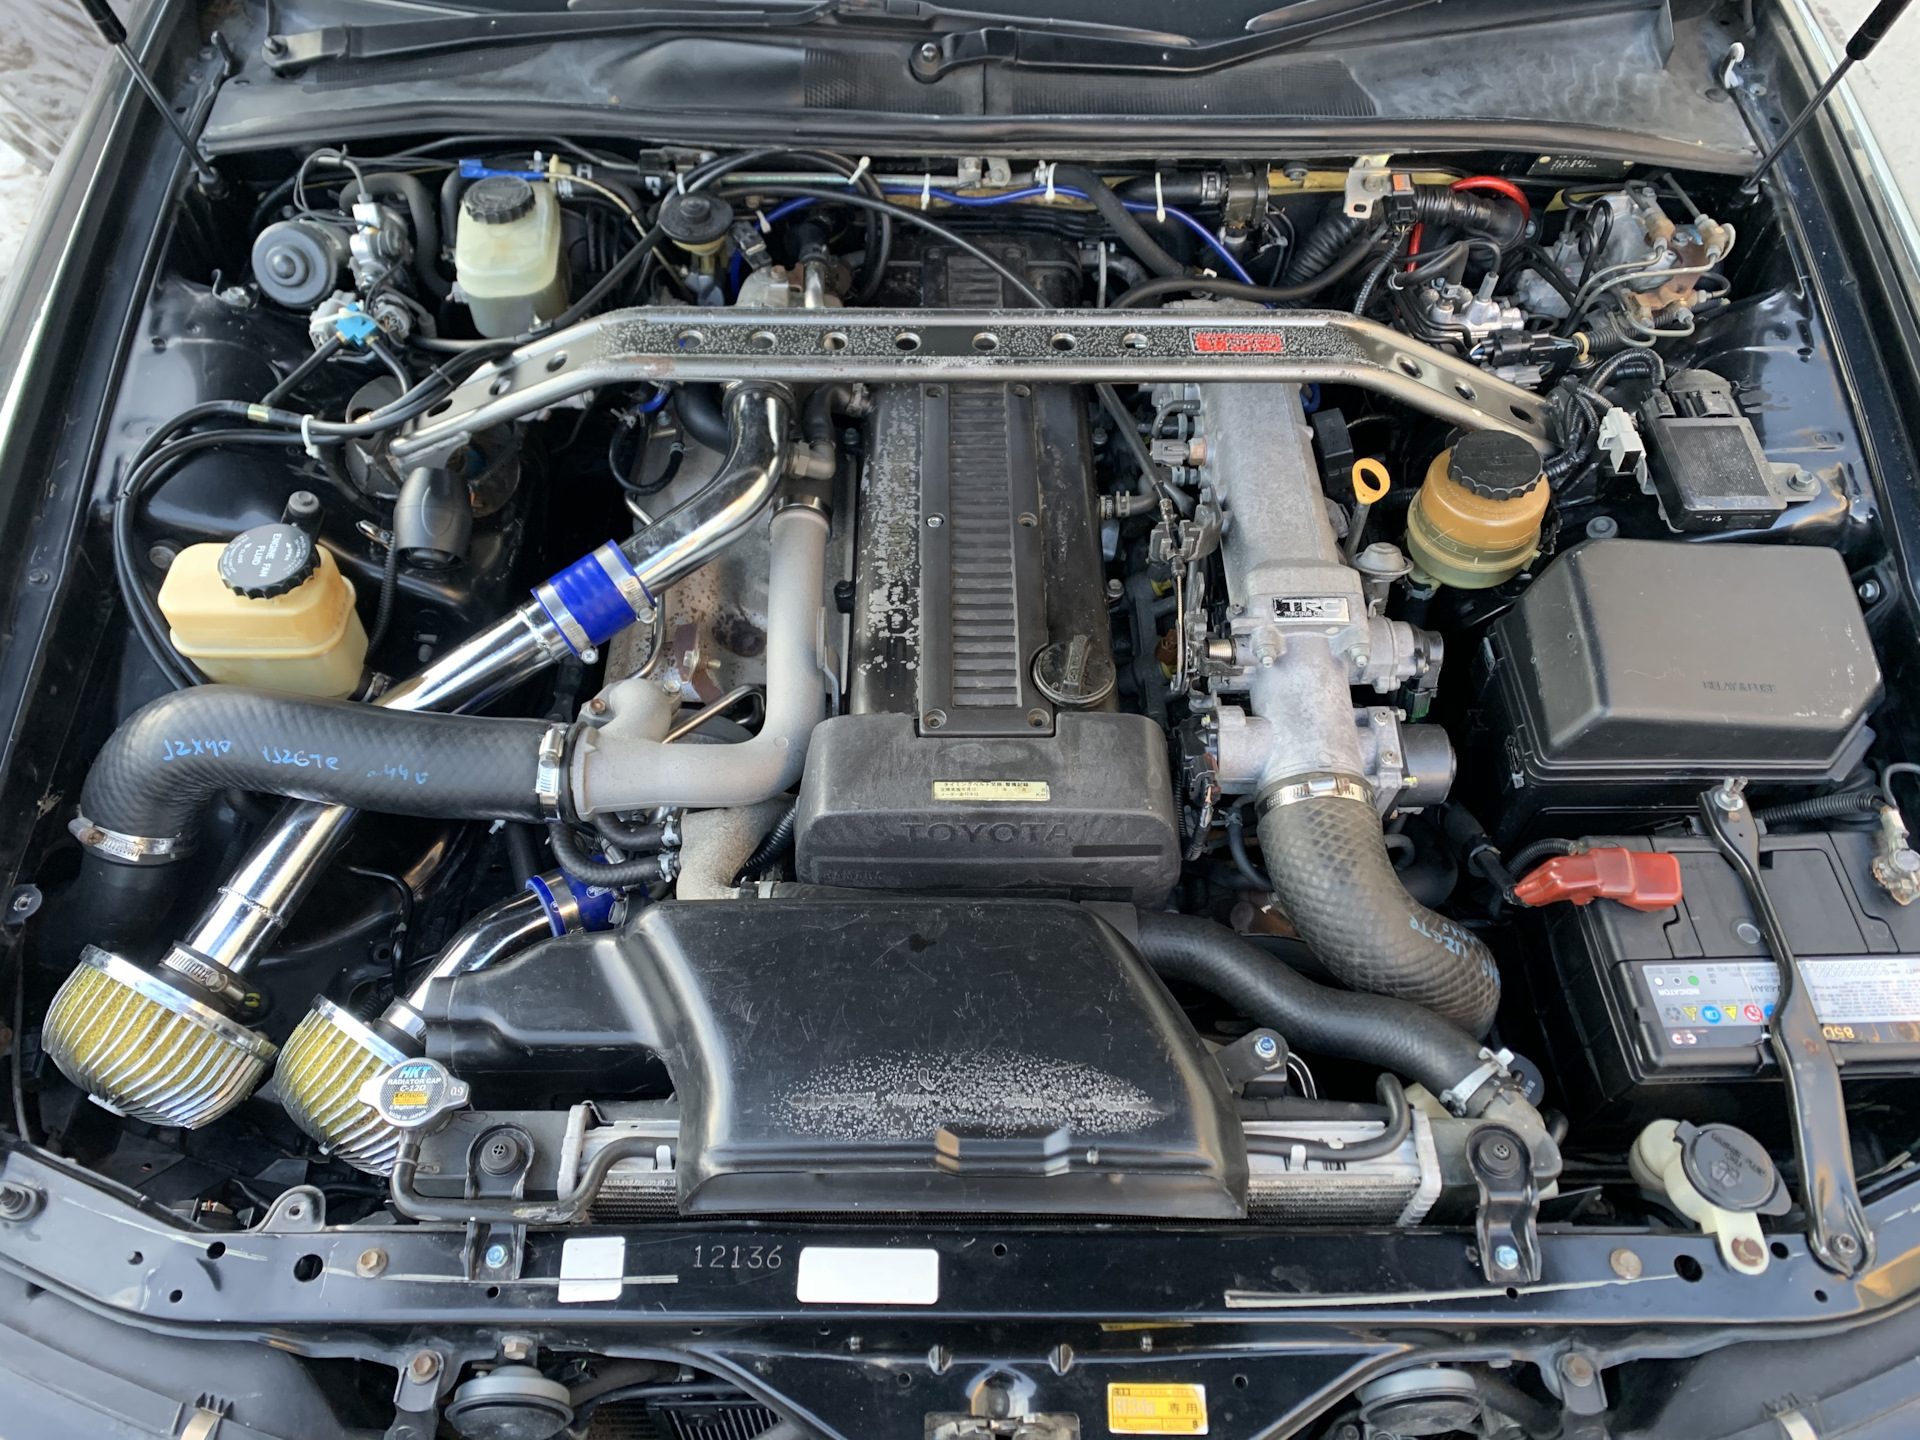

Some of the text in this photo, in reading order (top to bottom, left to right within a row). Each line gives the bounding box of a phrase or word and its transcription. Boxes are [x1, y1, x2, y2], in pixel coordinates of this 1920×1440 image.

[252, 545, 266, 565] FLUID
[259, 533, 282, 577] ENGINE FAN
[1282, 600, 1340, 612] TRC
[900, 822, 1074, 843] TOYOTA
[1658, 988, 1700, 996] INDICATOR
[399, 1066, 432, 1078] HKT
[692, 1245, 783, 1269] 12136
